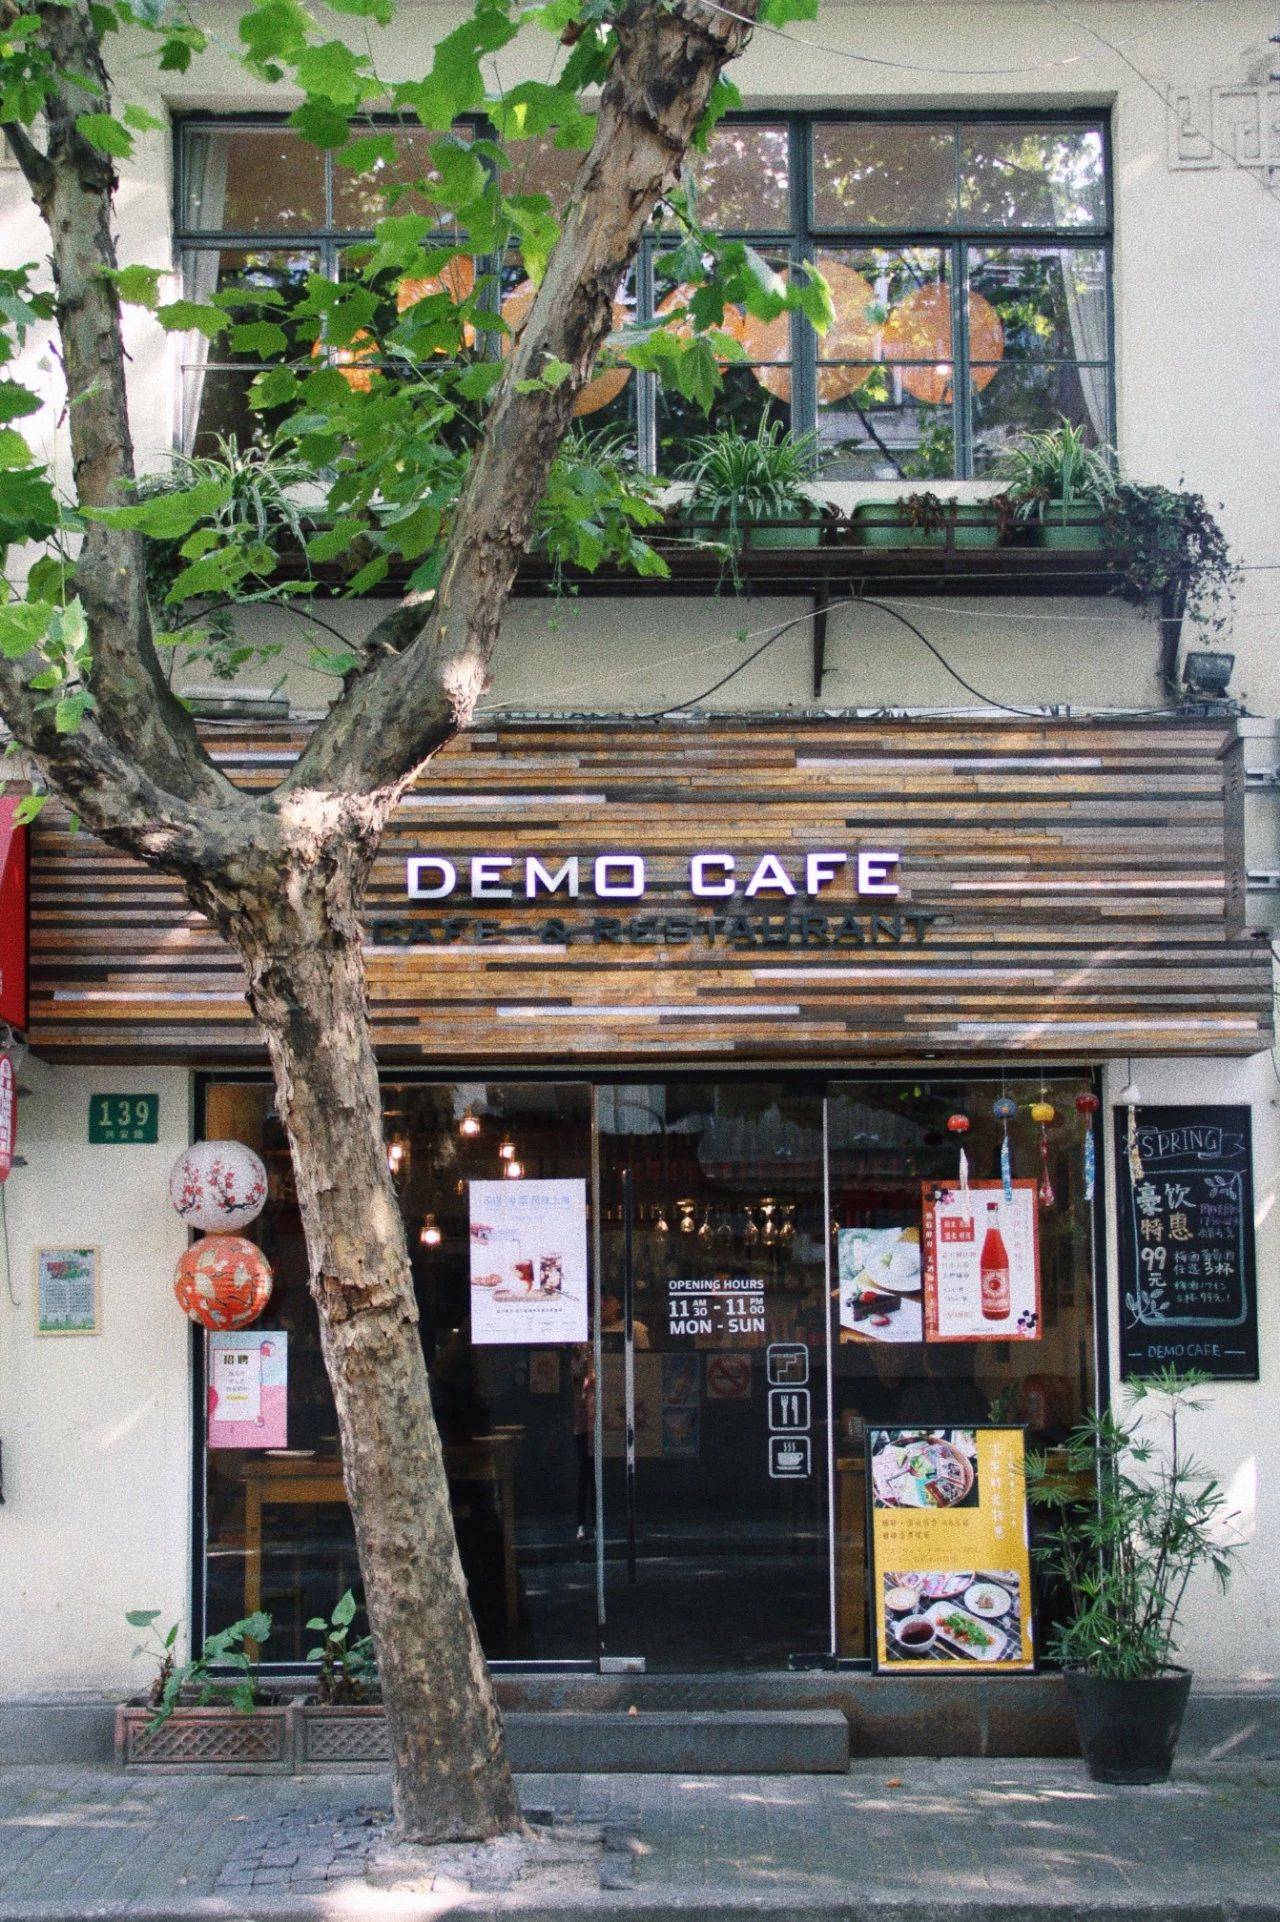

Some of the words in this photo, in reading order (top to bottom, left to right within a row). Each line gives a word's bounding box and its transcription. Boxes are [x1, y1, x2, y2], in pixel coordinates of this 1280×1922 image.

[406, 854, 646, 900] DEMO
[689, 852, 900, 898] CAFE
[372, 917, 501, 946] CAFE
[539, 918, 578, 946] &
[594, 913, 936, 945] RESTAURANT
[99, 1101, 149, 1126] 139
[1141, 1131, 1217, 1158] SPRING
[1137, 1182, 1196, 1216] 豪饮
[1140, 1211, 1195, 1242] 特惠
[1141, 1247, 1167, 1271] 99
[669, 1280, 721, 1289] OPENING
[723, 1279, 764, 1290] HOURS
[1148, 1272, 1168, 1288] 元
[669, 1300, 690, 1318] 11
[693, 1307, 708, 1317] 30
[726, 1298, 747, 1316] 11
[750, 1306, 764, 1314] 00
[670, 1320, 712, 1334] MON
[728, 1318, 765, 1333] SUN
[224, 1355, 248, 1364] 招聘
[1147, 1345, 1185, 1358] DEMO
[1186, 1343, 1222, 1358] CAFE
